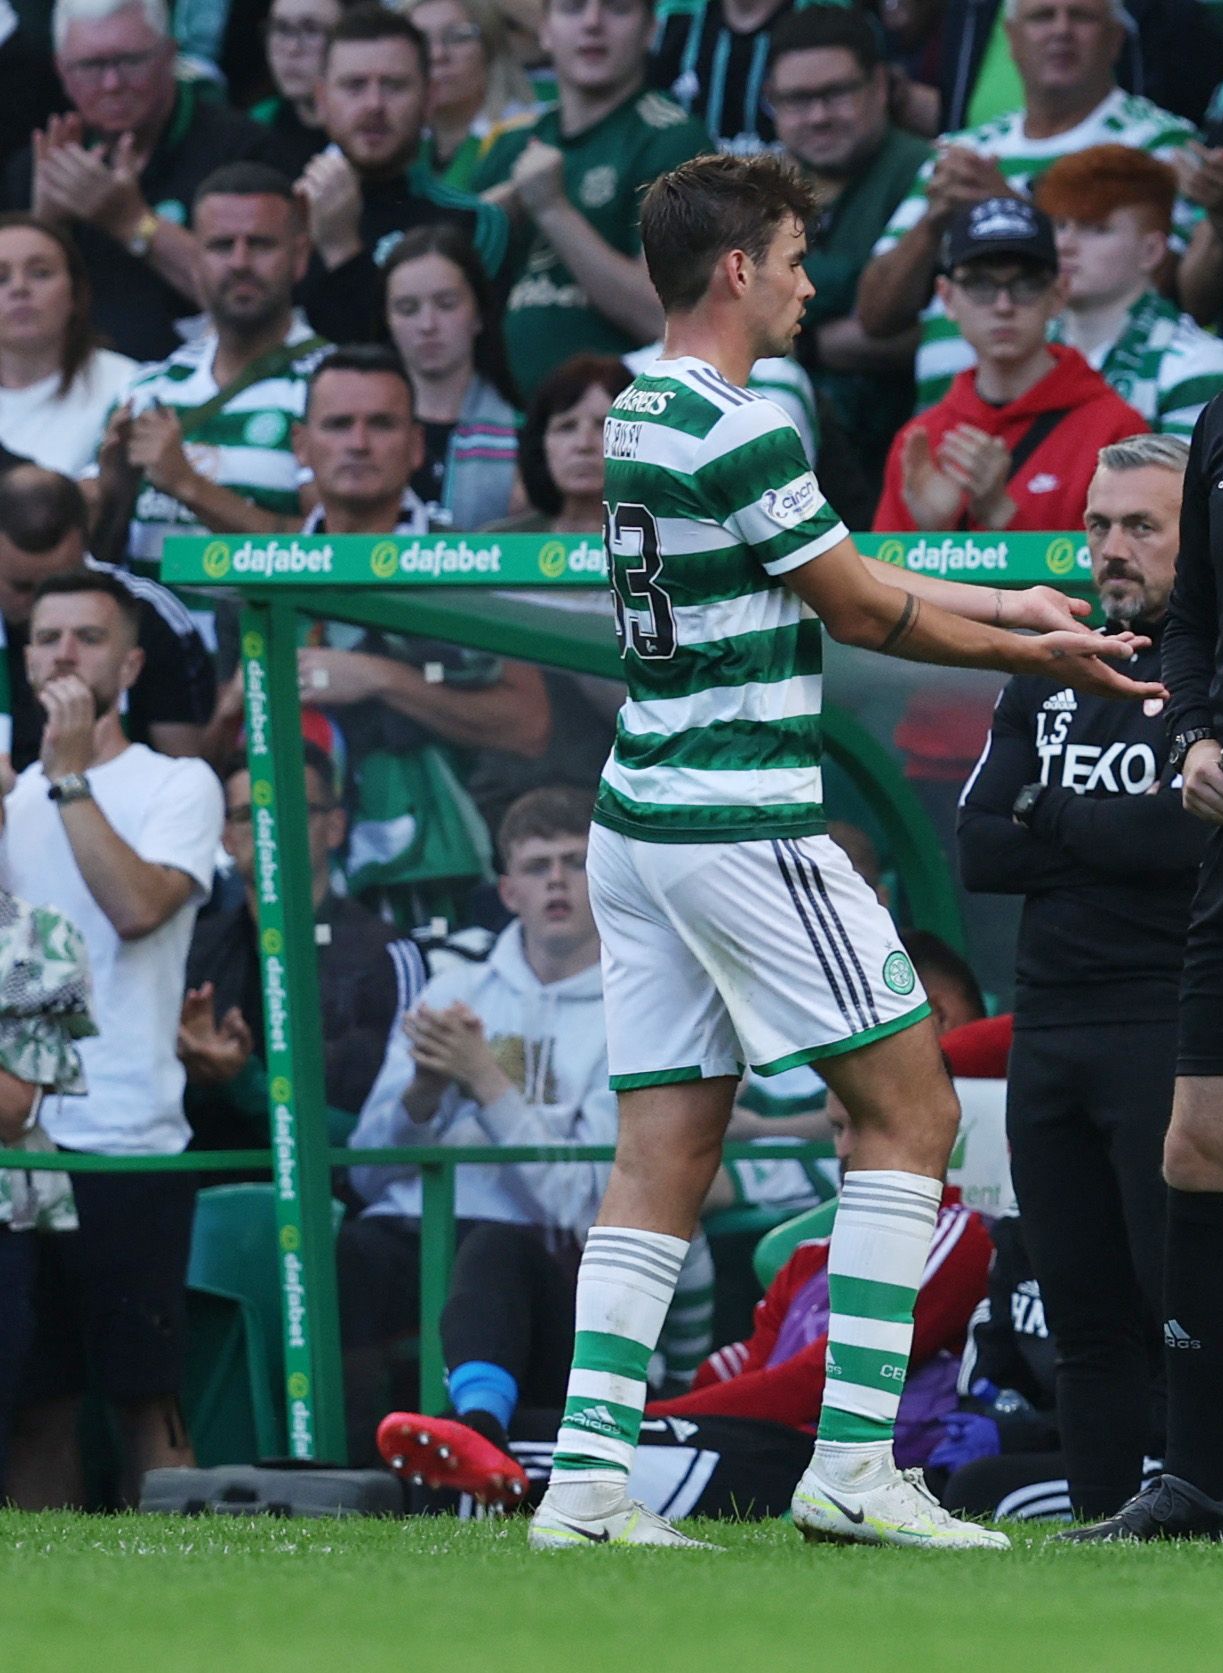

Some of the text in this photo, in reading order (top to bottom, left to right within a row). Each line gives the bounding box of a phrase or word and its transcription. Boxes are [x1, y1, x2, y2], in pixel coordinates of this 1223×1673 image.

[232, 541, 333, 577] dafabet
[400, 541, 501, 577] dafabet
[907, 538, 1008, 575] dafabet
[247, 659, 268, 755] dafabet
[1036, 711, 1073, 749] LS
[256, 807, 278, 904] dafabet
[265, 956, 287, 1052] dafabet
[274, 1104, 297, 1200] dafabet
[283, 1252, 305, 1346] dafabet
